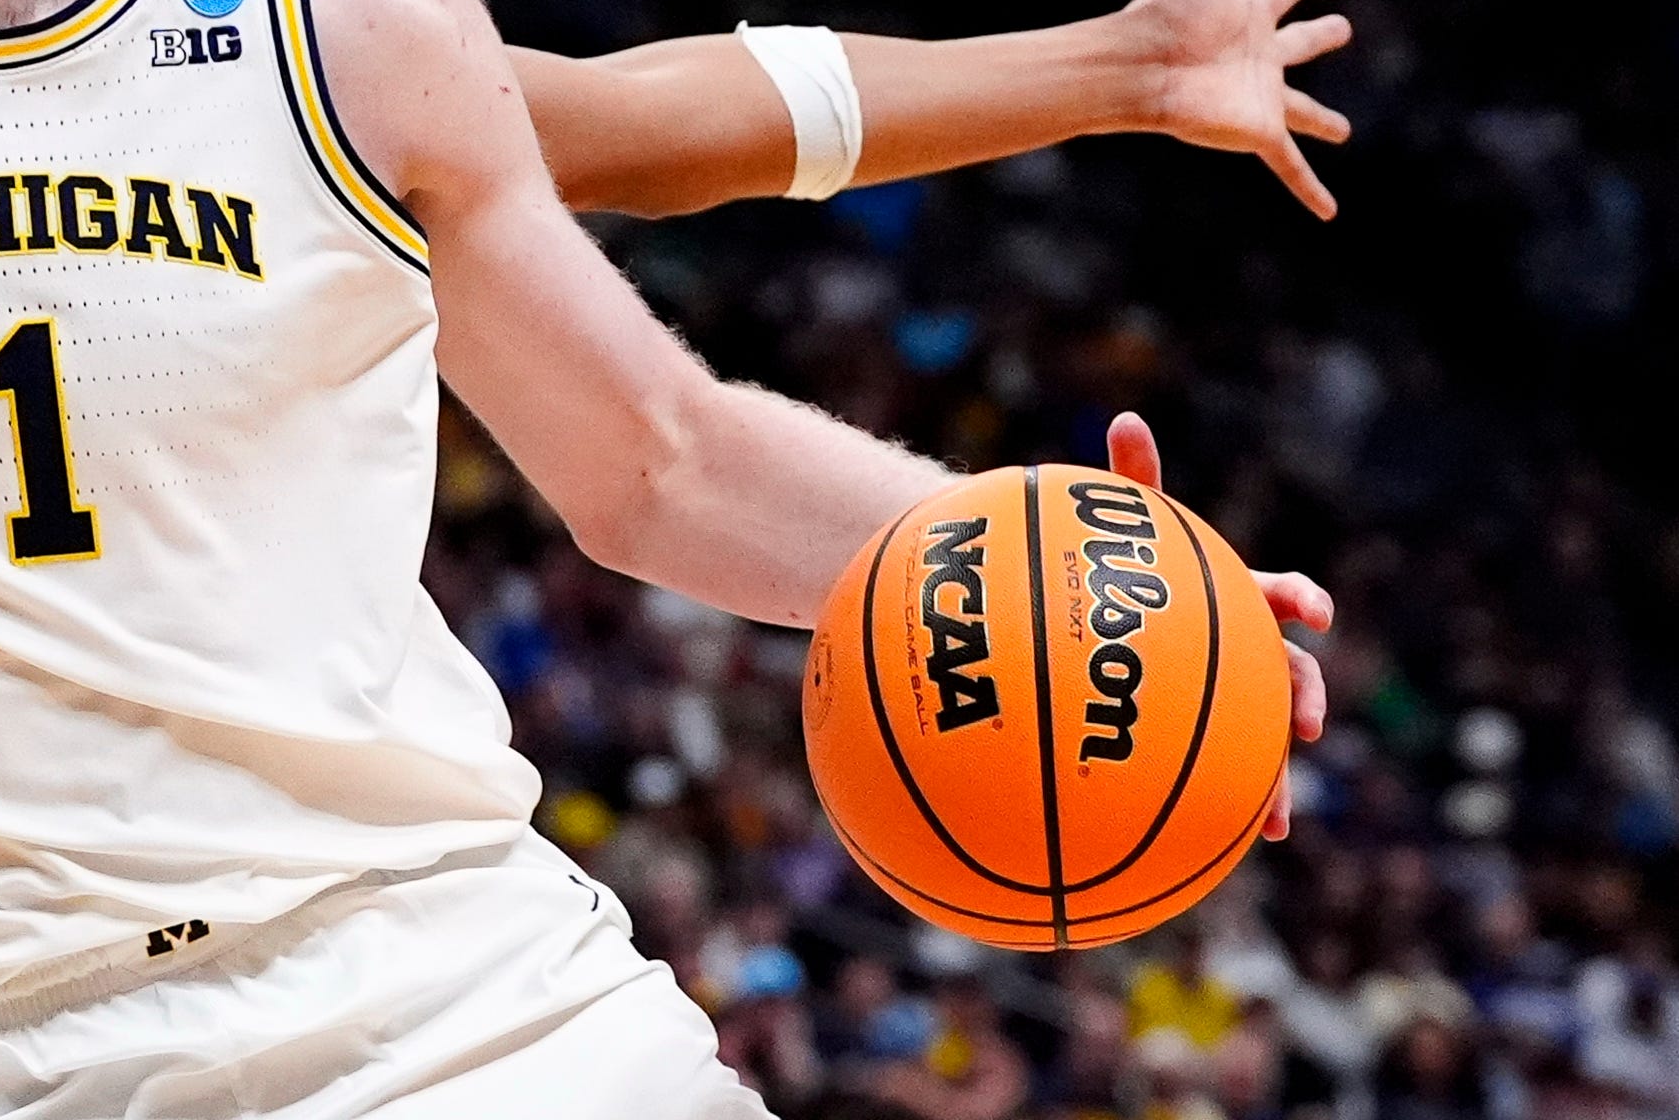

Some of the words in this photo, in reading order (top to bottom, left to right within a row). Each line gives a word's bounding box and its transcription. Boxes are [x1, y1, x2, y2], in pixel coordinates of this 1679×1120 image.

[910, 675, 932, 736] BALL
[921, 516, 1002, 734] NCAA
[1066, 480, 1171, 764] Wilson
